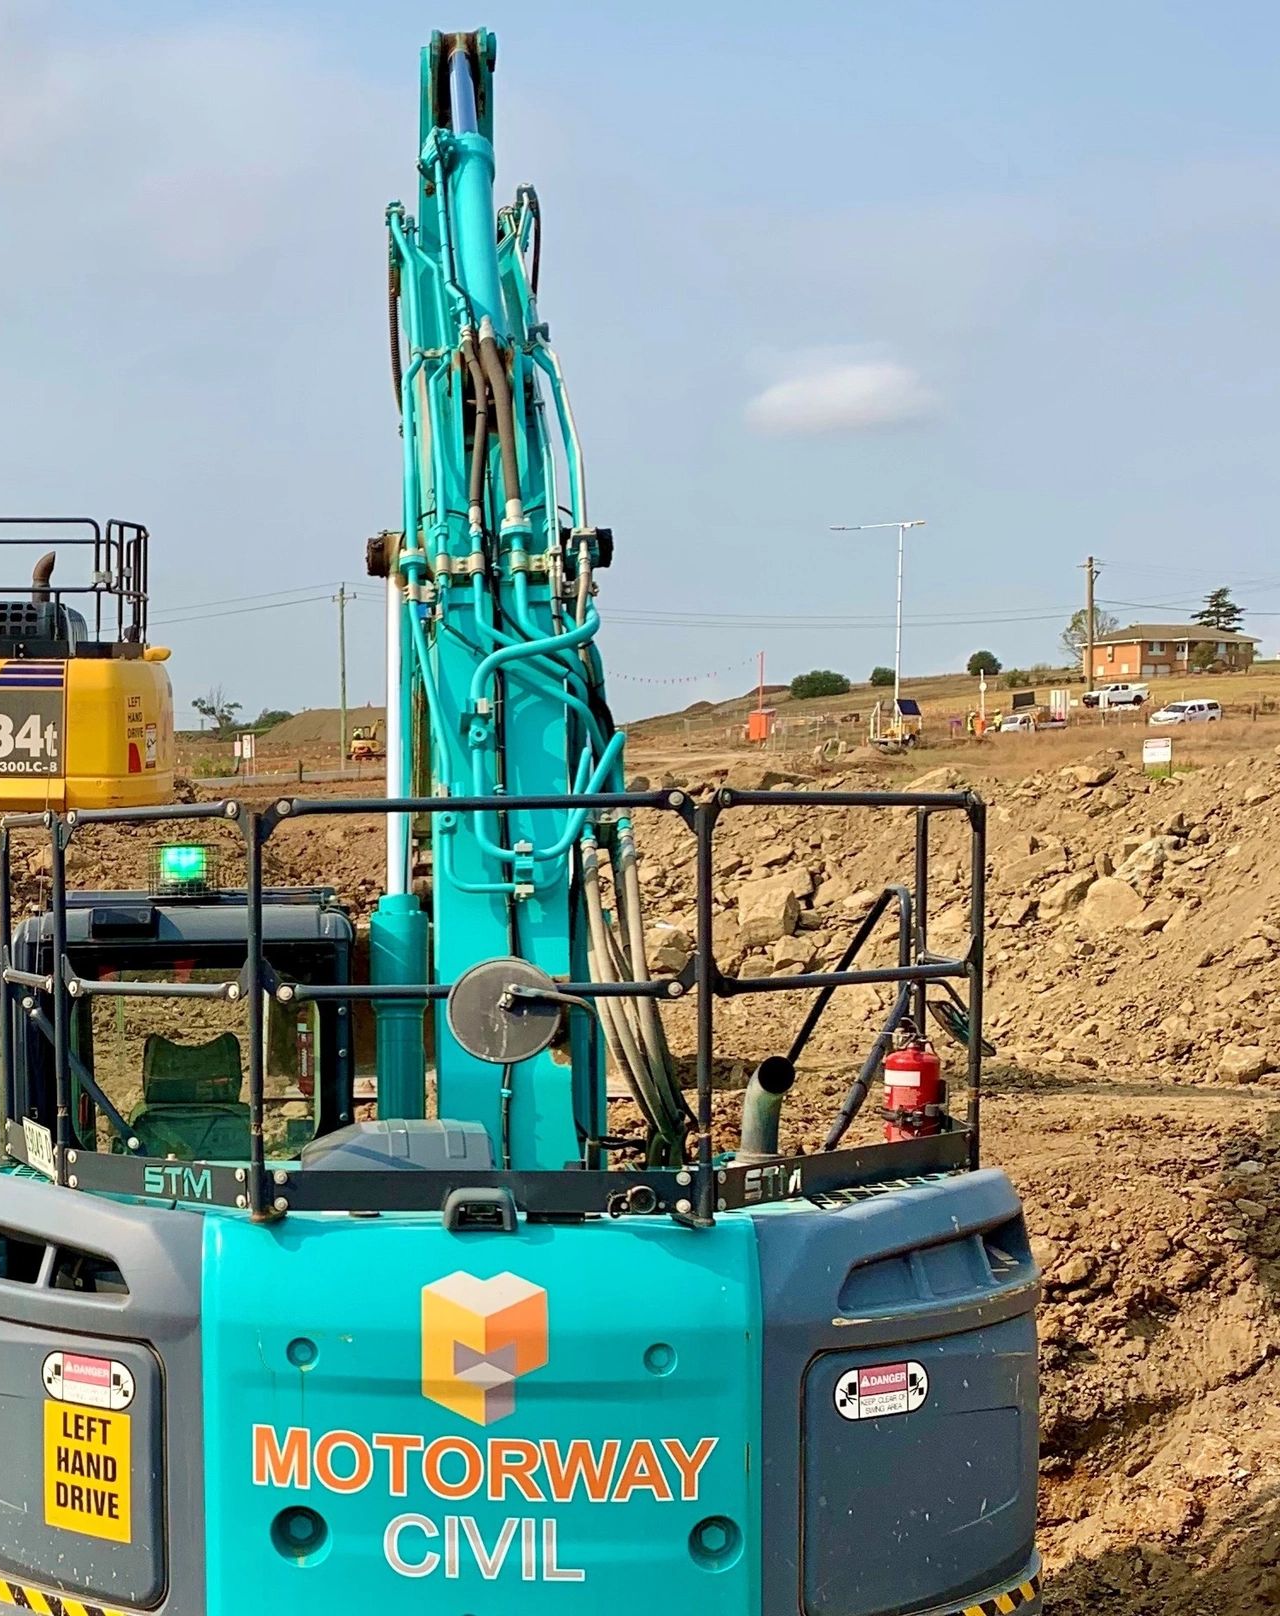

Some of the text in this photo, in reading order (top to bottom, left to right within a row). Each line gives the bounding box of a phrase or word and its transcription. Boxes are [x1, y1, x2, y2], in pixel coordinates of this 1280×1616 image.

[128, 696, 141, 708] LEFT
[128, 712, 143, 723] HAND
[128, 727, 144, 739] DRIVE
[144, 1164, 213, 1200] STM
[73, 1364, 110, 1378] DANGER
[870, 1371, 907, 1387] DANGER
[861, 1397, 877, 1406] KEEP
[878, 1394, 898, 1404] CLEAR
[865, 1403, 903, 1415] SWING AREA
[63, 1411, 112, 1445] LEFT
[57, 1446, 117, 1482] HAND
[252, 1424, 720, 1503] MOTORWAY
[56, 1481, 119, 1520] DRIVE
[384, 1512, 586, 1582] CIVIL
